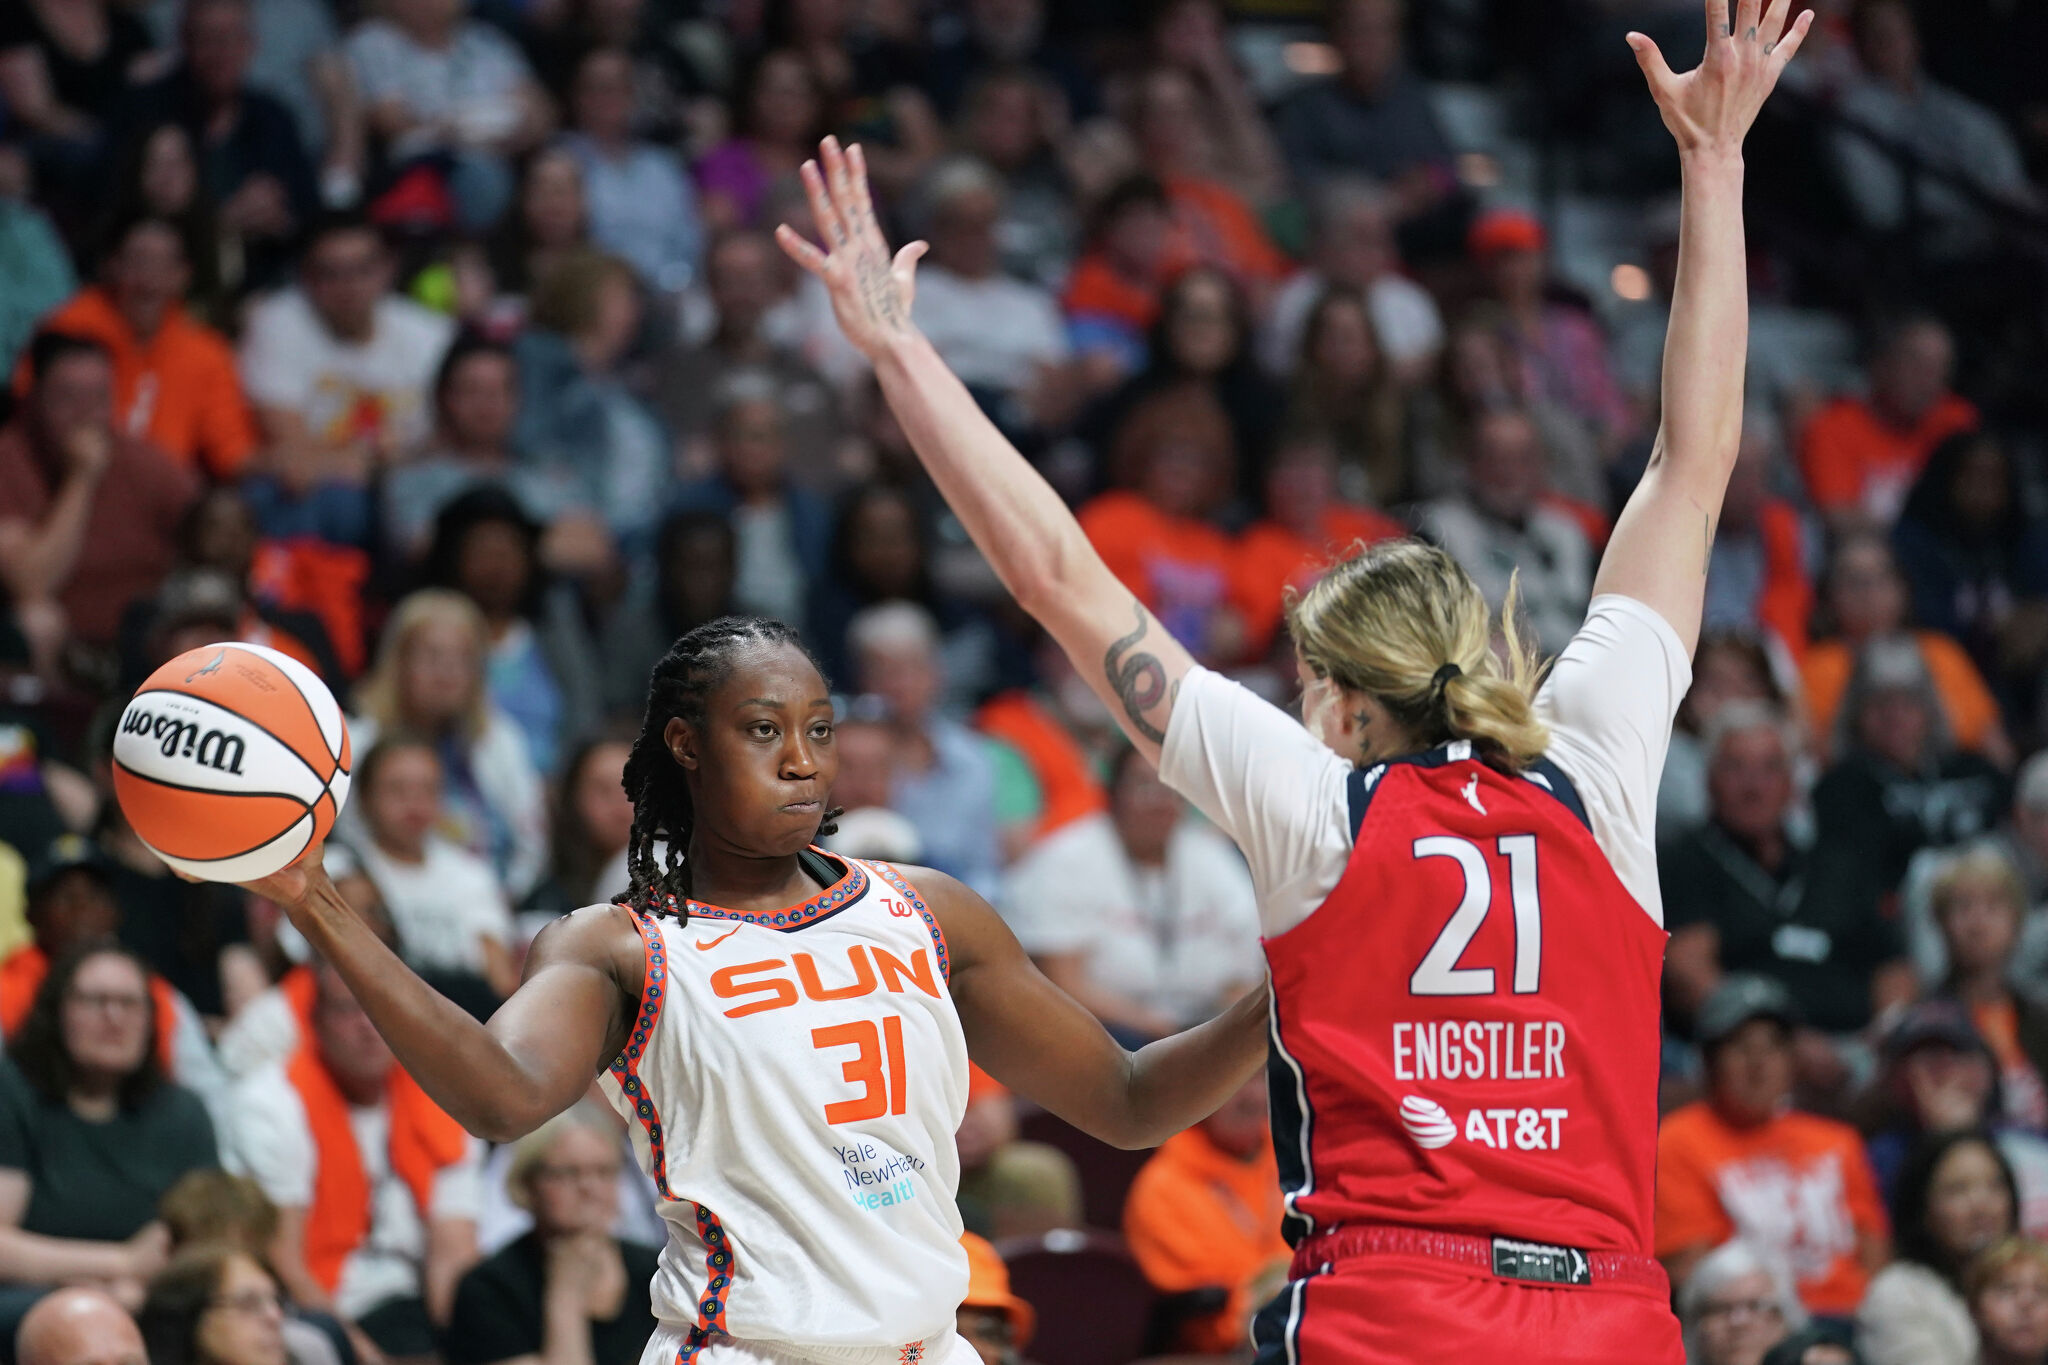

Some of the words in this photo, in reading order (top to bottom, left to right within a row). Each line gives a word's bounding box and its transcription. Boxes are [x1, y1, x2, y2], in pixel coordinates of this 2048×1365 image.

[122, 706, 246, 776] Wilson
[1409, 833, 1542, 996] 21
[710, 944, 942, 1018] SUN
[811, 1015, 906, 1125] 31
[1393, 1020, 1566, 1080] ENGSTLER
[833, 1142, 877, 1164] Yale
[1465, 1107, 1568, 1150] AT&T
[843, 1154, 925, 1190] NewHaen
